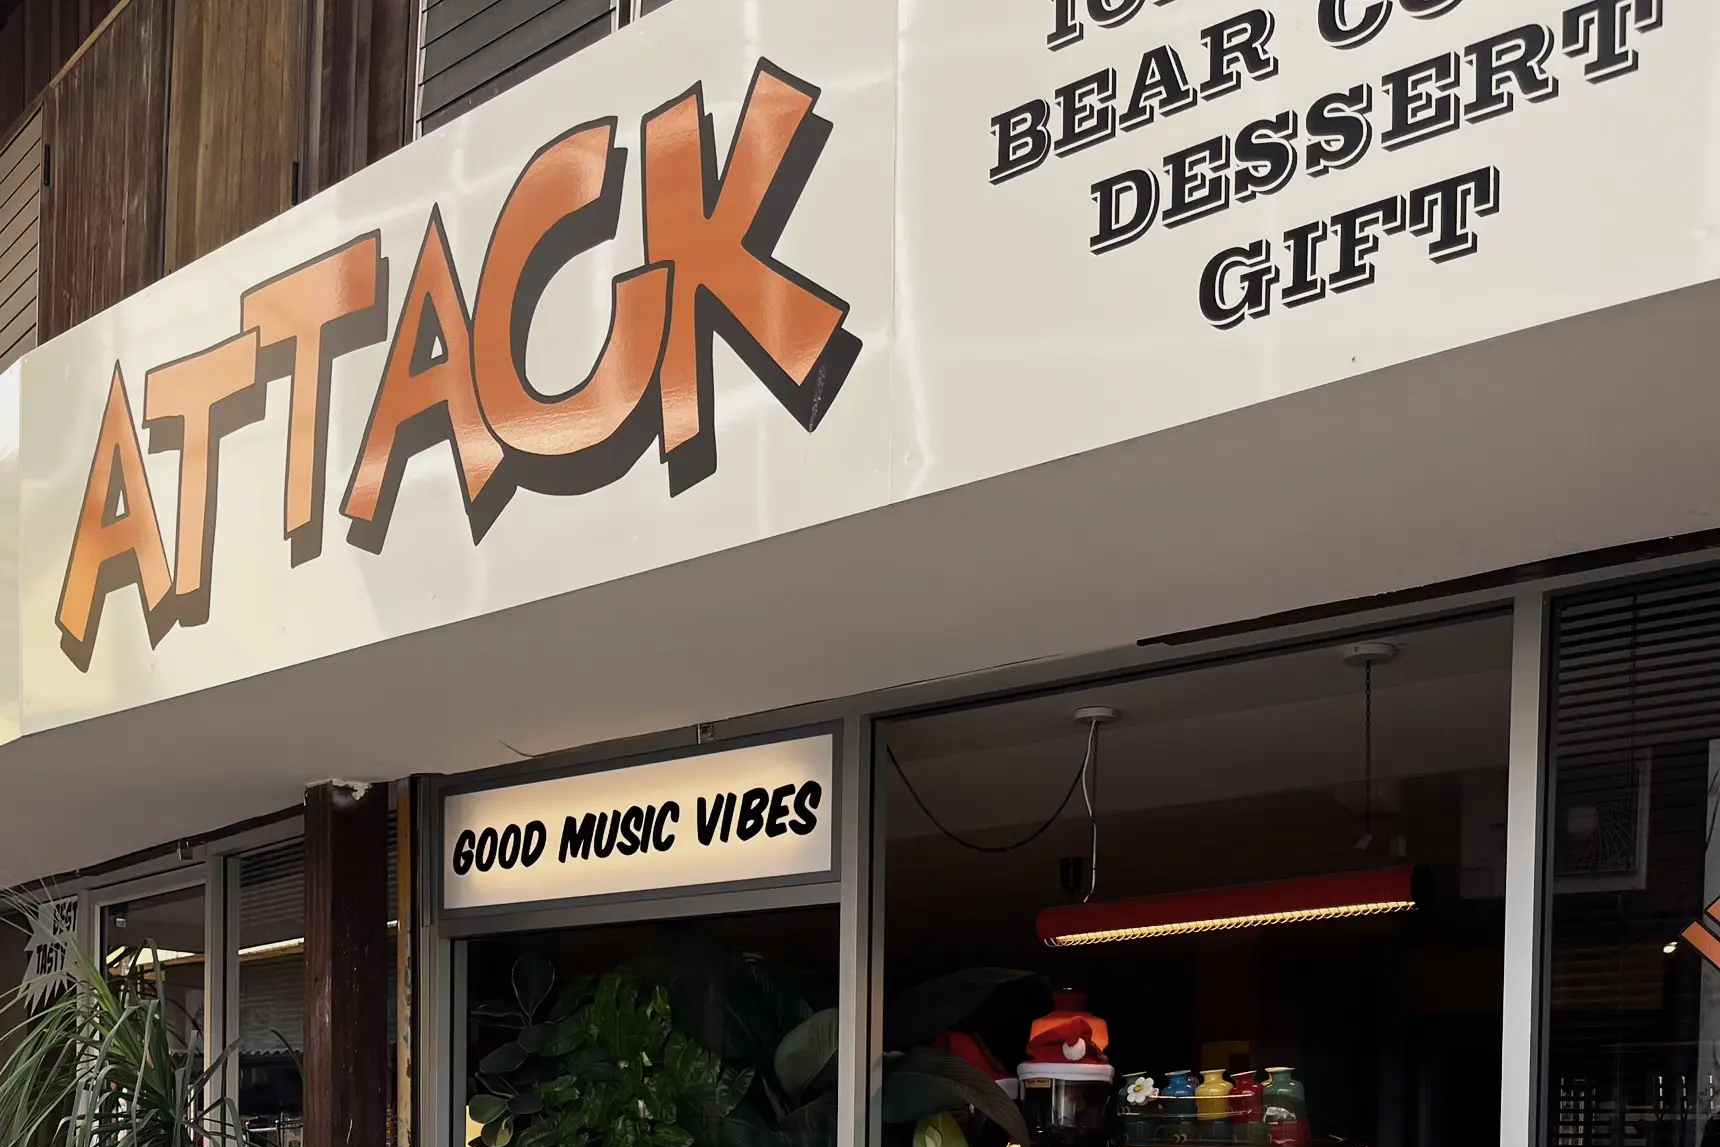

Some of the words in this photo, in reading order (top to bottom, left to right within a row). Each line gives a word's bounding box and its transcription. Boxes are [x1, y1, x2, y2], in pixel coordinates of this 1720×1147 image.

[990, 8, 1279, 185] BEAR
[1089, 0, 1664, 255] DESSERT
[1199, 164, 1501, 331] GIFT
[55, 56, 863, 673] ATTACK
[452, 819, 547, 876] GOOD
[558, 800, 680, 864] MUSIC
[696, 780, 823, 846] VIBES
